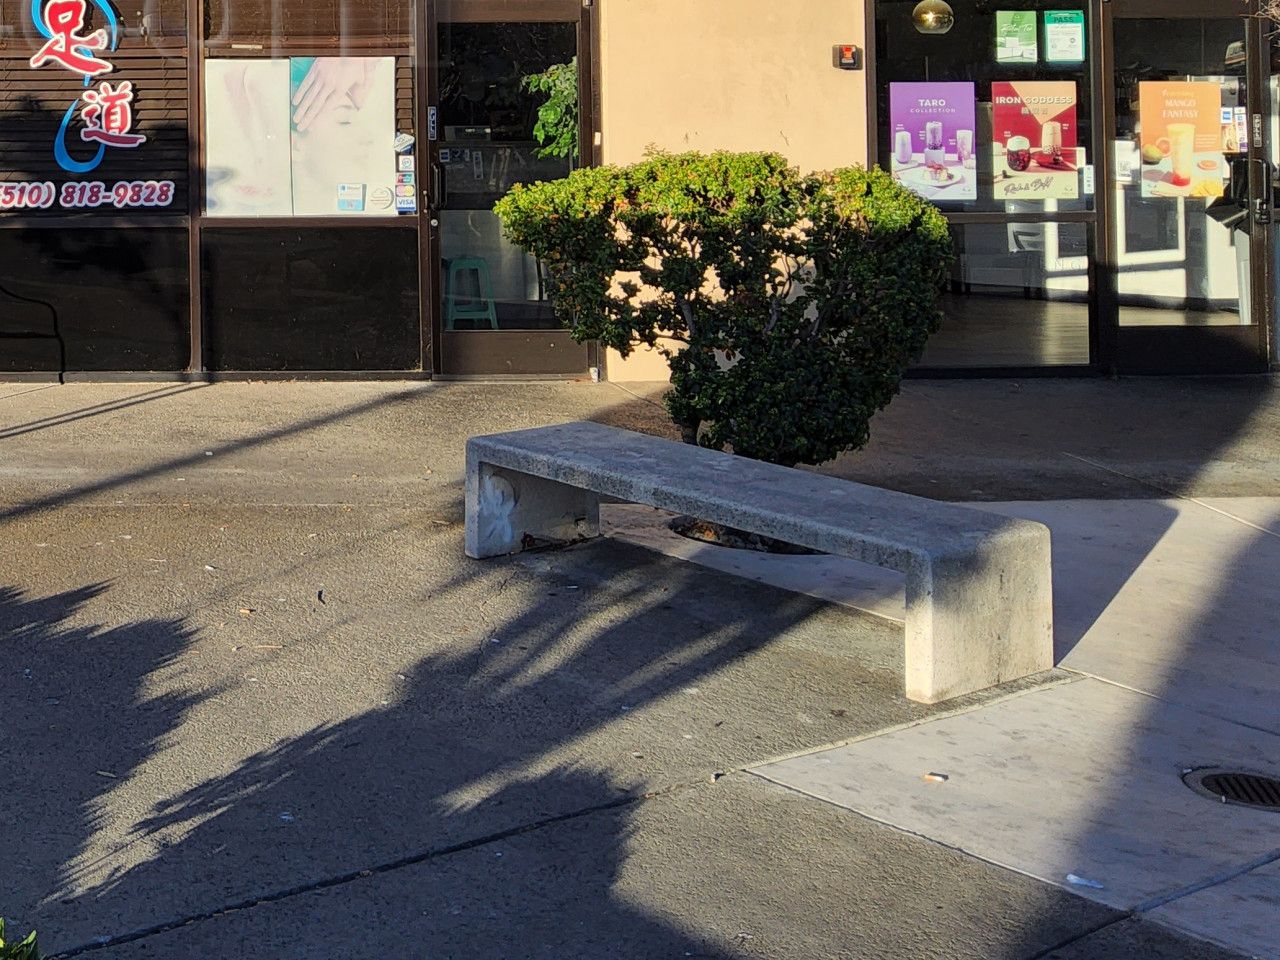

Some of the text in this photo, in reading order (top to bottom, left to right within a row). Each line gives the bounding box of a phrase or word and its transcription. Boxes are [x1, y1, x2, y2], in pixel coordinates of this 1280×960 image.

[918, 99, 946, 107] TARO
[995, 96, 1073, 104] IRON GODDESS
[59, 180, 175, 209] 818-9828
